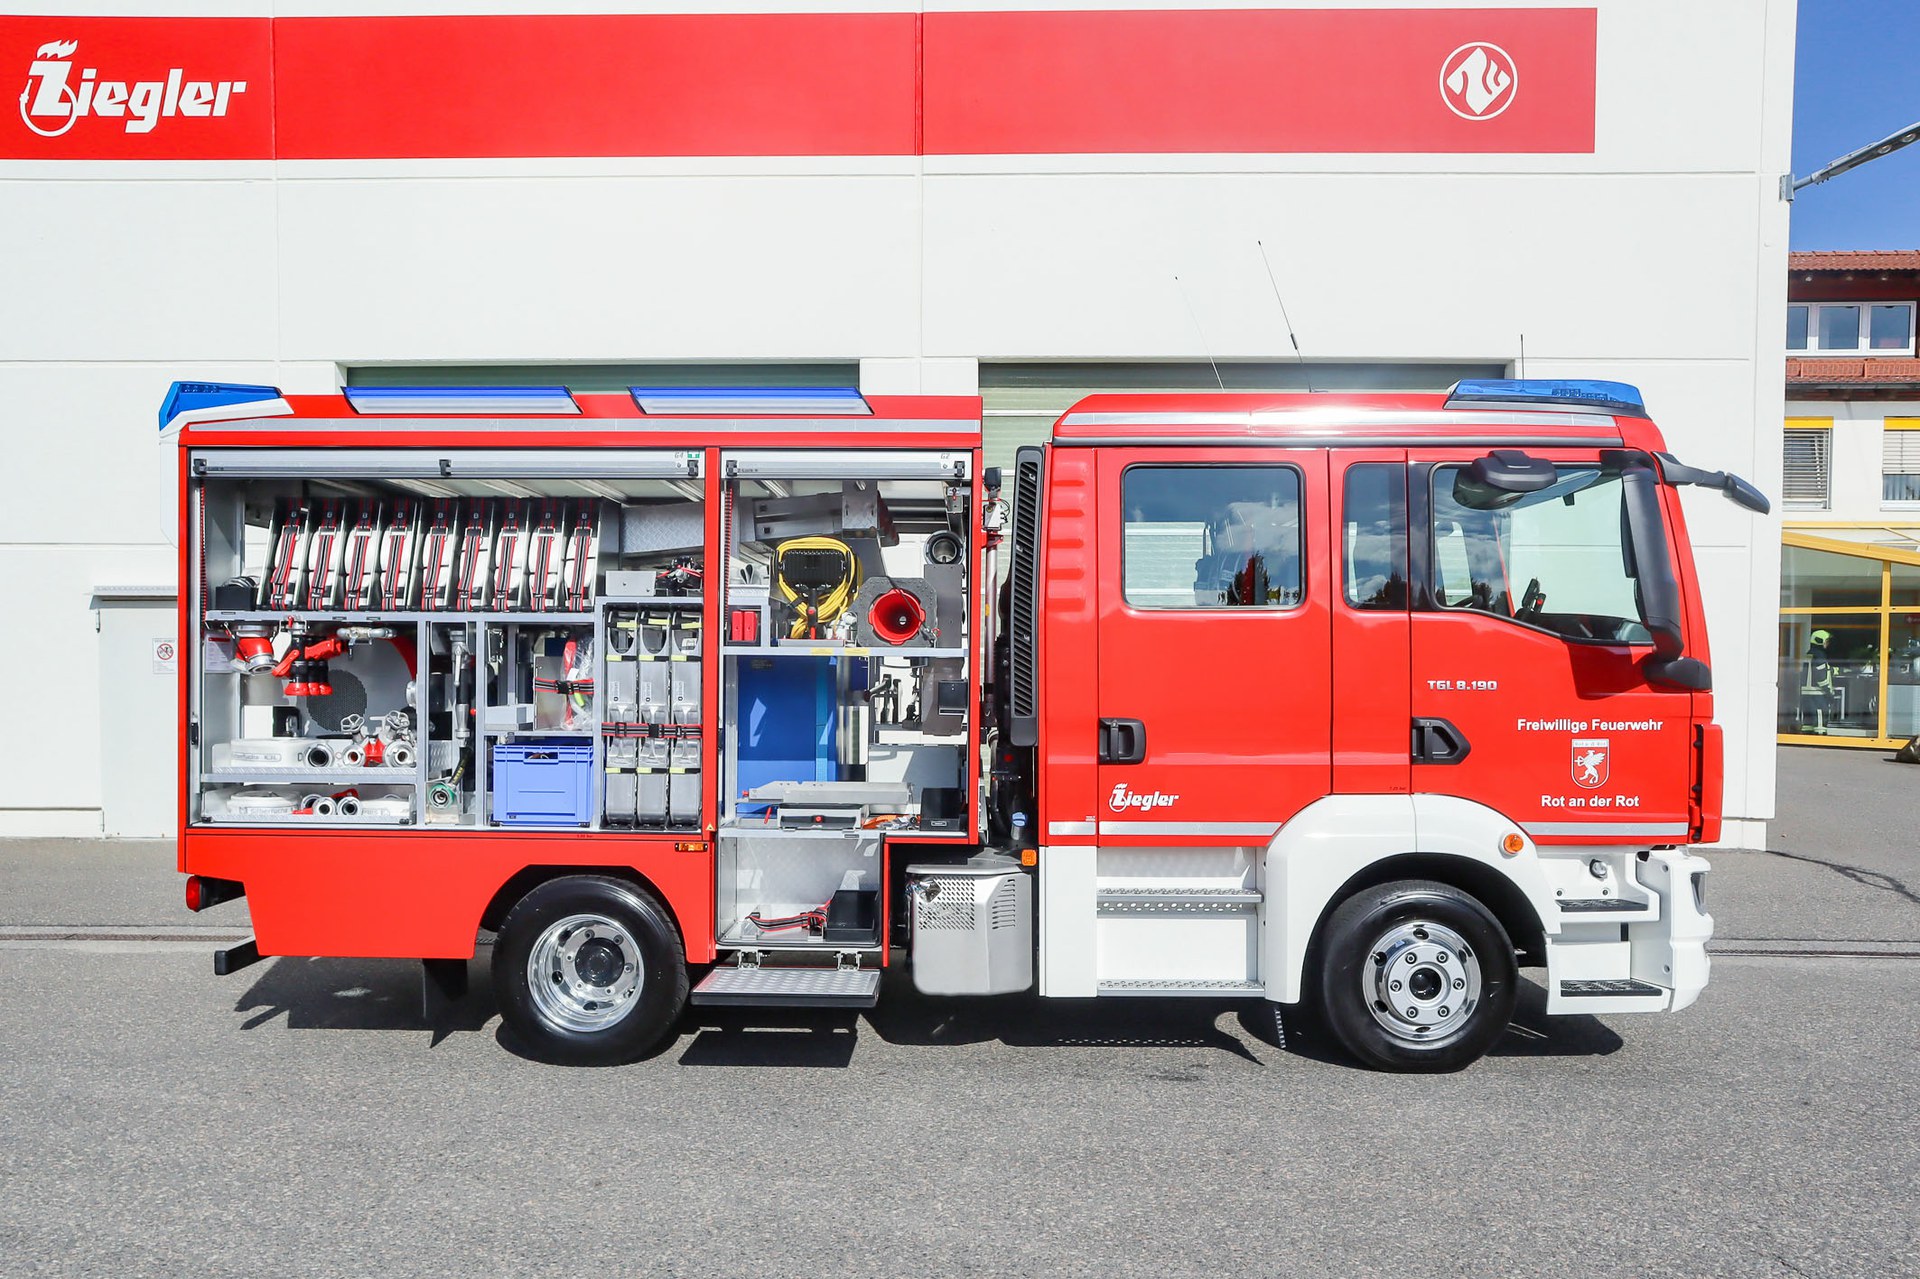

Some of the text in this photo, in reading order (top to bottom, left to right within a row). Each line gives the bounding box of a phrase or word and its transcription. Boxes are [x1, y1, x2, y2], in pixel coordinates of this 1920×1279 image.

[19, 58, 247, 137] Ziegler
[1427, 680, 1497, 690] TGL 8.190
[1517, 719, 1663, 733] Freiwillige Feuerwehr
[1109, 787, 1179, 812] Ziegler
[1541, 795, 1639, 806] Rot an der Rot
